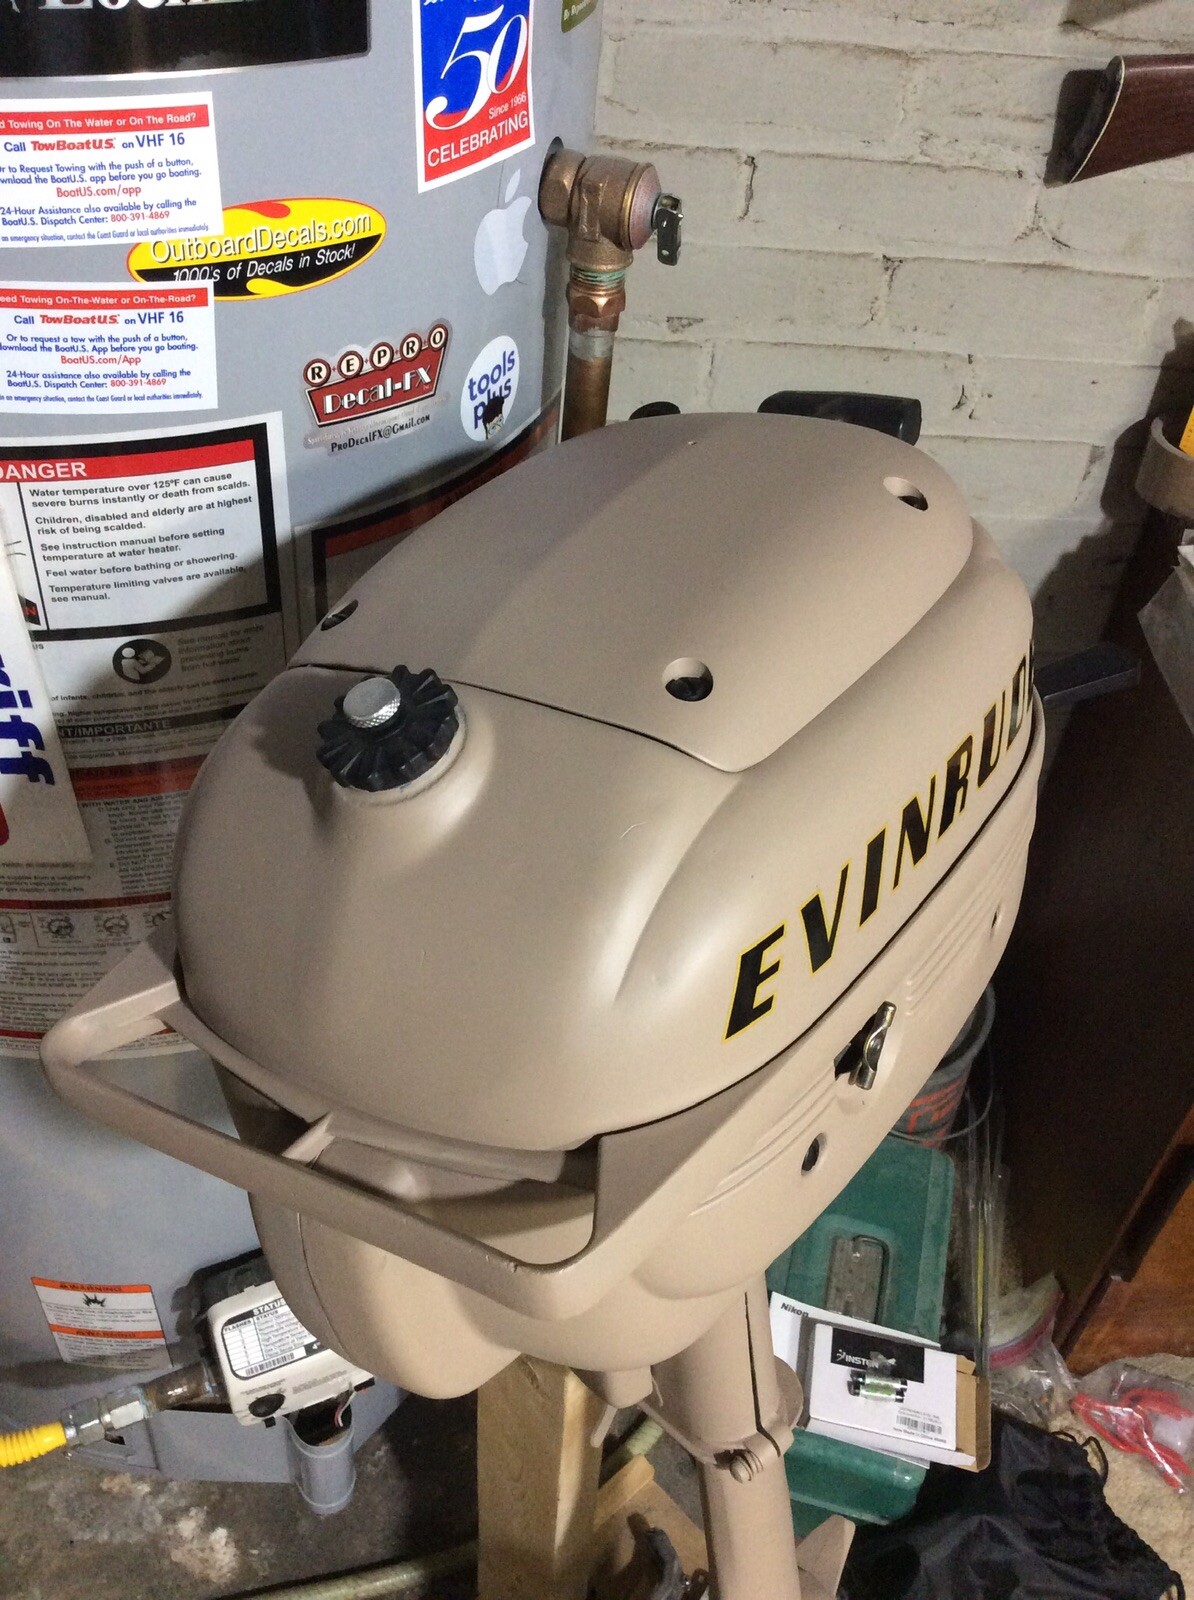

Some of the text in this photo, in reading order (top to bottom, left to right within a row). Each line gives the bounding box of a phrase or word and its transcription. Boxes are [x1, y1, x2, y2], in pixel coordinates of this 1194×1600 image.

[426, 4, 528, 130] 50
[489, 92, 526, 120] Since 1966
[7, 113, 196, 131] Towing On The Water or On The Road?
[4, 142, 26, 152] Call
[122, 141, 134, 149] on
[135, 133, 164, 148] VHF
[169, 132, 185, 146] 16
[427, 110, 528, 167] CELEBRATING
[9, 165, 18, 173] to
[19, 164, 53, 175] Request
[55, 164, 86, 174] Towing
[87, 162, 107, 171] with
[108, 161, 122, 170] the
[124, 161, 144, 172] push
[147, 159, 156, 169] of
[165, 158, 194, 168] button,
[34, 174, 48, 184] the
[50, 174, 87, 184] BoatU.S.
[89, 175, 106, 185] app
[108, 171, 136, 182] before
[138, 172, 153, 181] you
[155, 171, 166, 181] go
[168, 168, 202, 180] boating.
[56, 186, 142, 198] BoatUS.com/app
[1, 198, 197, 216] 24-Hour Assistance also available by calling the
[1, 211, 170, 227] BoatU.S. Dispatch Center: 800-391-4869
[151, 215, 371, 264] OutboardDecals.com
[173, 243, 356, 282] 1000's of Decals in Stock!
[19, 295, 53, 306] Towing
[55, 296, 118, 305] On-The-Water
[133, 294, 196, 304] On-The-Road?
[14, 315, 35, 325] Call
[124, 317, 136, 325] on
[137, 312, 165, 325] VHF
[170, 311, 184, 323] 16
[6, 334, 18, 342] Or
[20, 334, 29, 343] to
[30, 335, 61, 346] request
[70, 335, 86, 343] tow
[88, 334, 105, 343] with
[108, 334, 120, 343] the
[122, 334, 141, 345] push
[143, 333, 152, 342] of
[161, 333, 188, 343] button,
[40, 343, 52, 352] the
[55, 344, 89, 352] BoatU.S.
[92, 344, 108, 354] App
[110, 343, 136, 352] before
[138, 345, 152, 354] you
[155, 345, 165, 354] go
[167, 342, 198, 352] boating.
[60, 355, 141, 365] BoatUS.com/App
[6, 368, 191, 379] 24-Hour assistance also available by calling the
[468, 351, 515, 401] tools
[7, 378, 166, 390] BoatU.S. Dispatch Center: 800-391-4869
[323, 365, 431, 414] Decal-FX
[29, 488, 60, 498] Water
[62, 485, 125, 497] temperature
[128, 482, 150, 491] over
[183, 477, 201, 485] can
[203, 473, 232, 483] cause
[32, 481, 250, 508] severe burns instantly or death from scalds.
[35, 496, 252, 525] Children, disabled and elderly are at highest
[38, 522, 146, 535] risk of being scalded.
[40, 527, 225, 552] See instruction manual before setting
[42, 544, 181, 562] temperature at water heater.
[45, 552, 238, 577] Feel water before bathing or showering.
[49, 583, 111, 595] Temperature
[113, 579, 150, 590] limiting
[152, 575, 184, 585] valves
[186, 573, 201, 581] are
[51, 592, 110, 603] see manual.
[781, 1302, 809, 1318] Nikon
